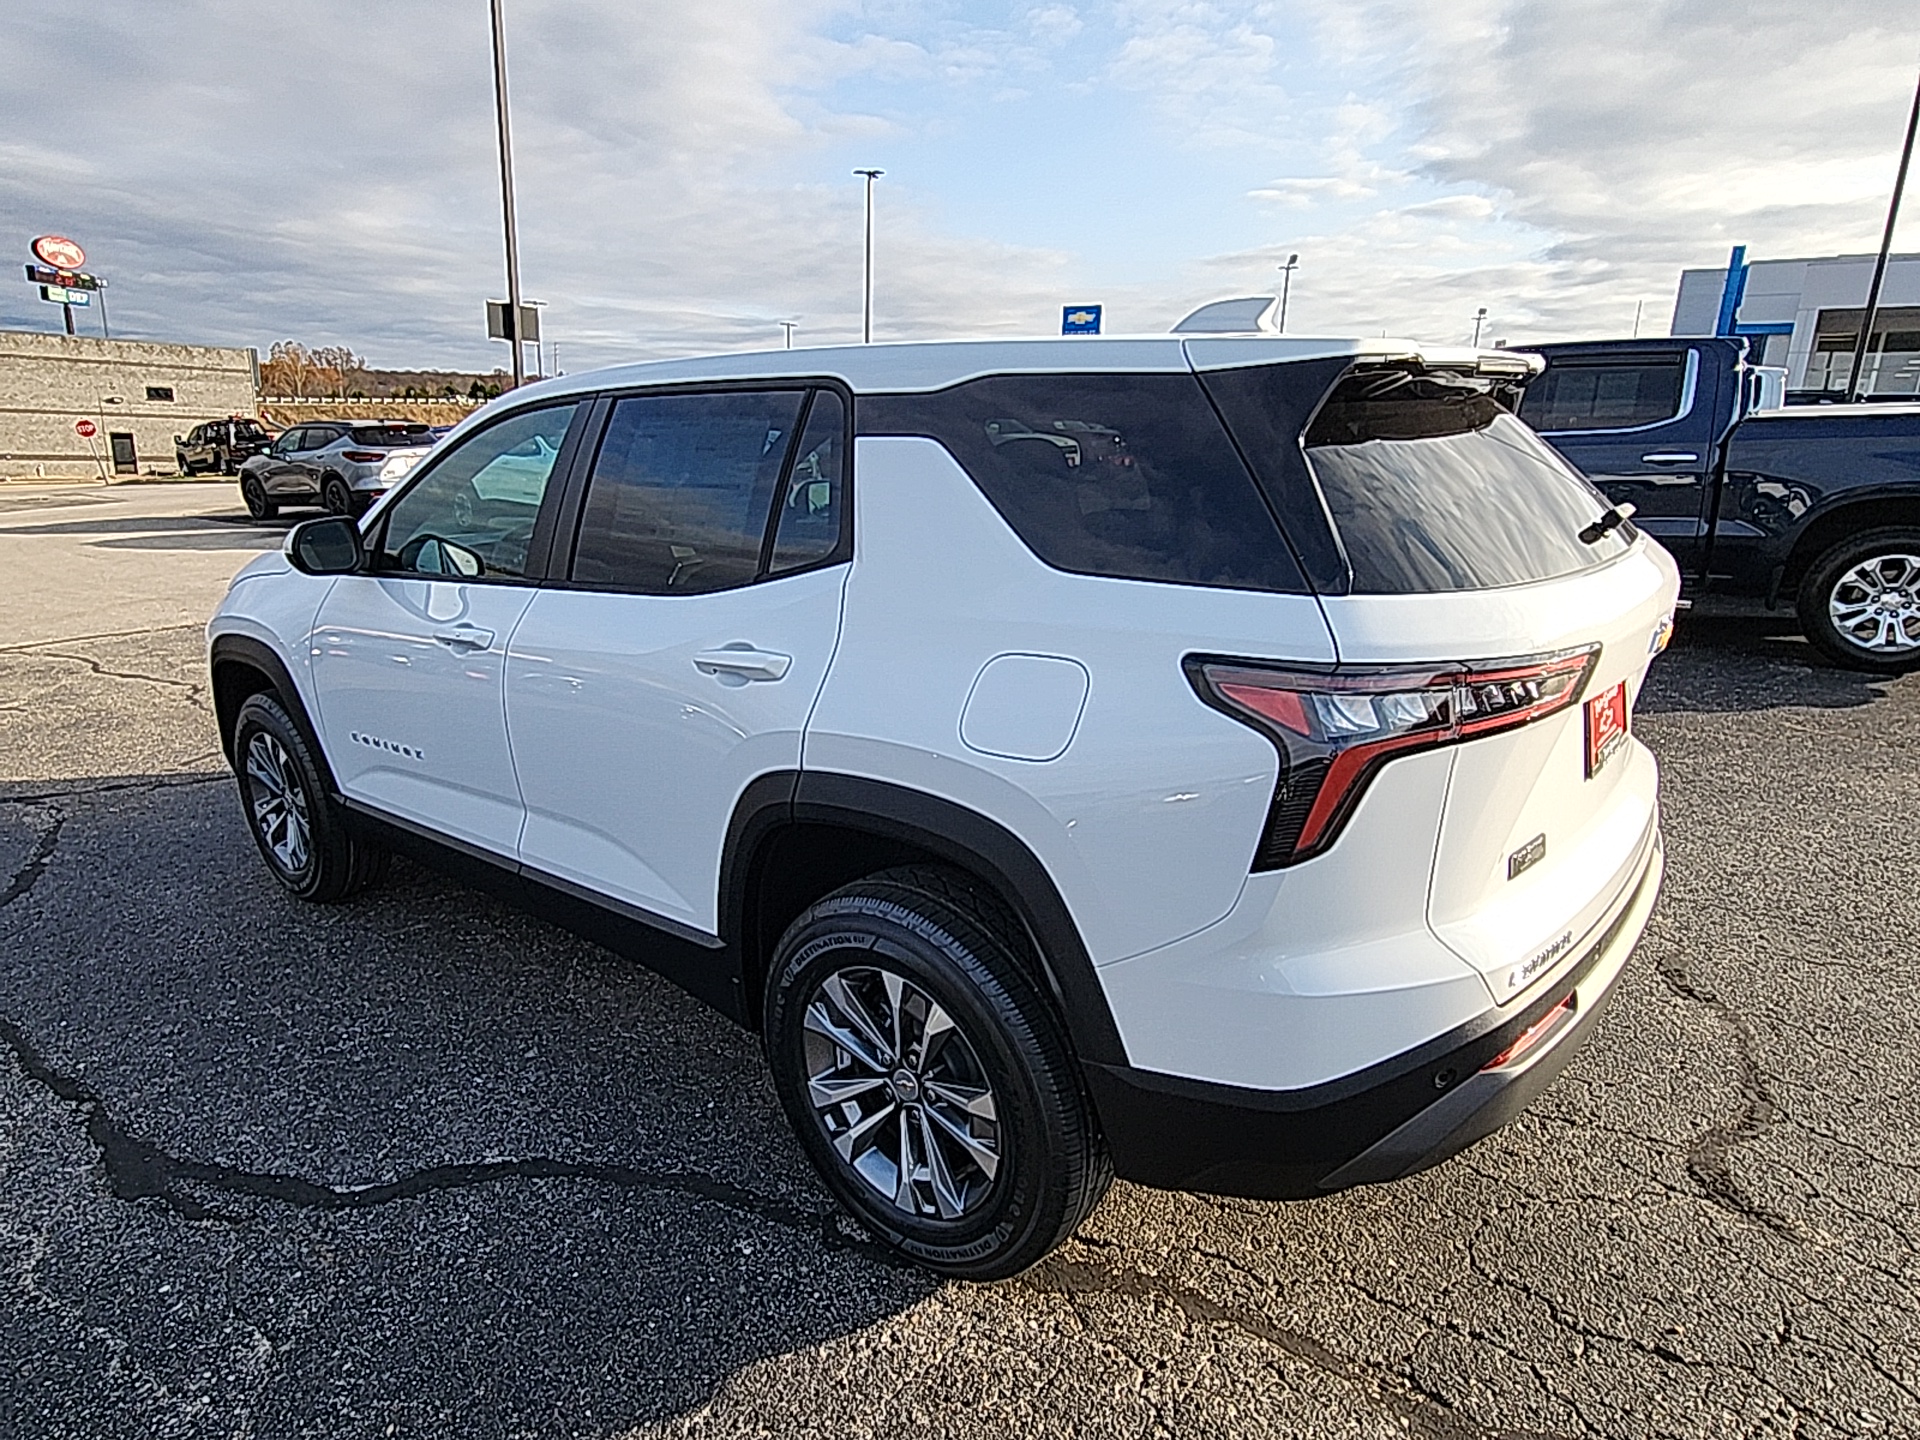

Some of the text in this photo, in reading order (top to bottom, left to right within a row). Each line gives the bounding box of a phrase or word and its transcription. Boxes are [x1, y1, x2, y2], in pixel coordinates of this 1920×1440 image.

[76, 424, 94, 433] STOP
[351, 732, 425, 760] EQUINOX
[794, 935, 853, 967] DESTINATION
